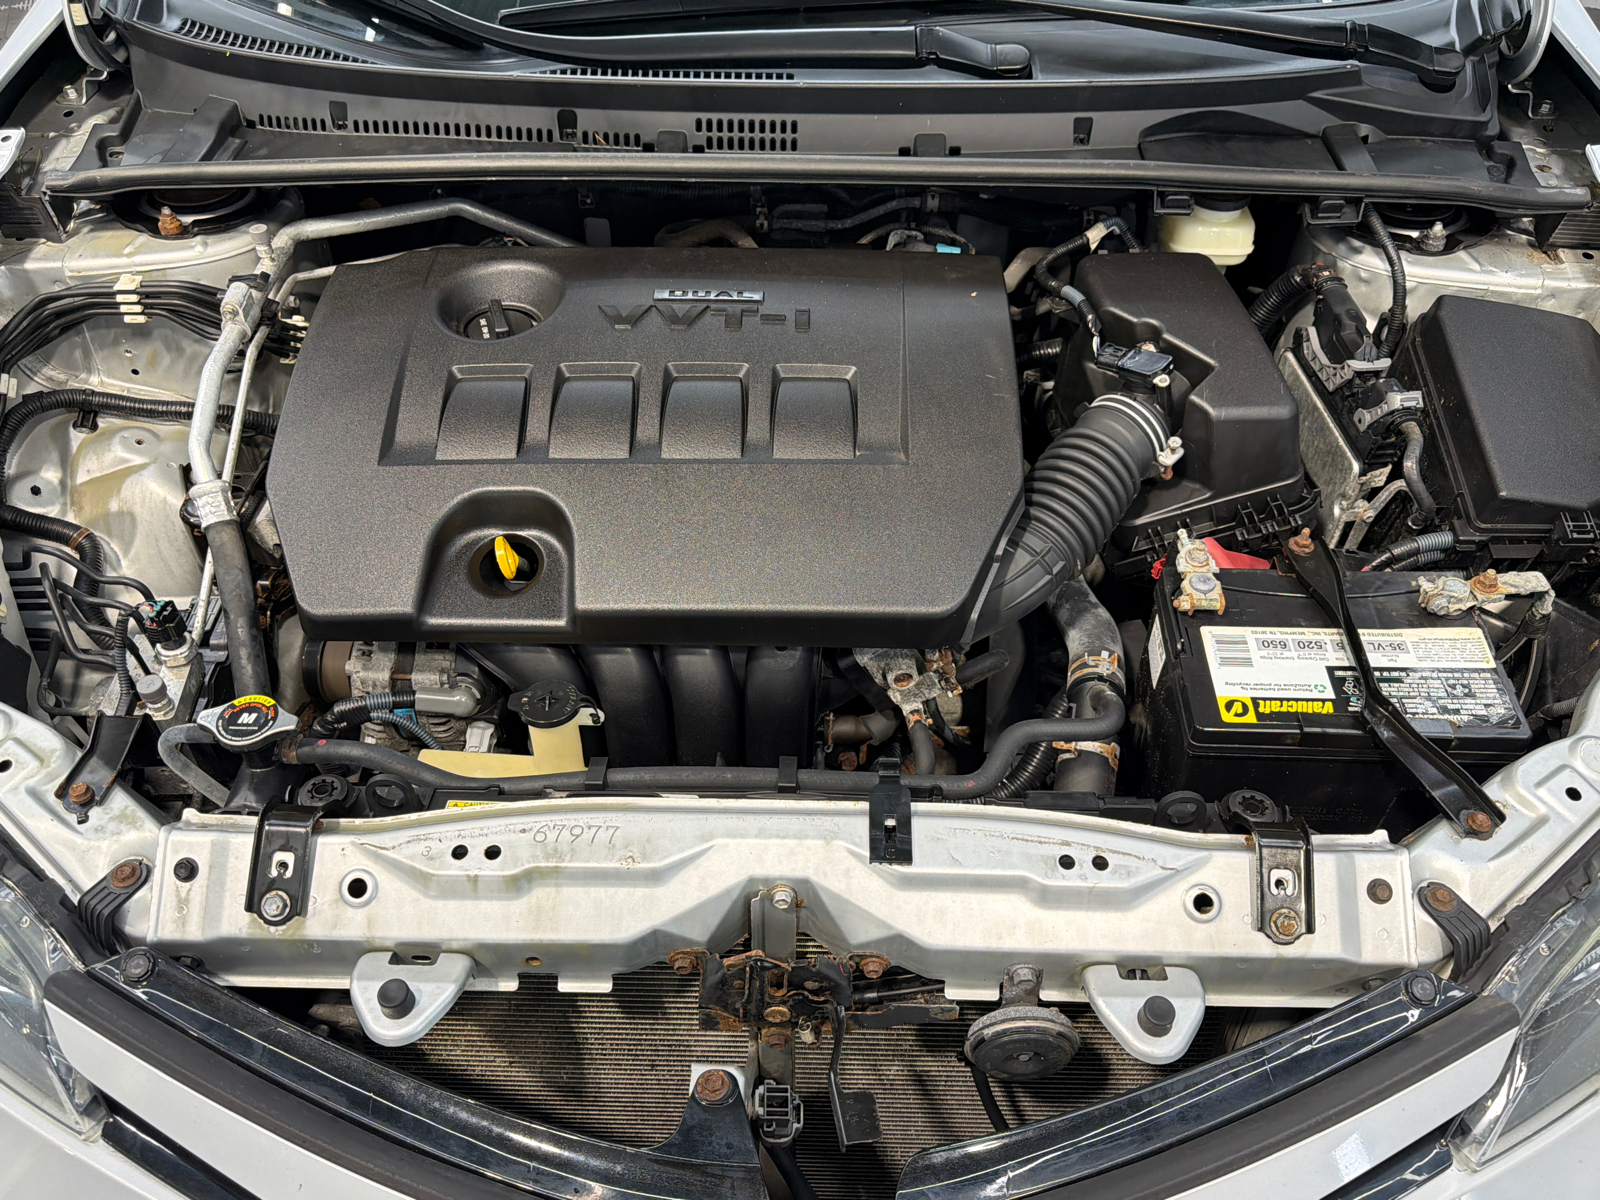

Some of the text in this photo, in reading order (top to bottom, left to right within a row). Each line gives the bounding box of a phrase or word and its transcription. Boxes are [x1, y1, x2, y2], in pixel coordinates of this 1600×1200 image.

[668, 290, 754, 299] DUAL
[1261, 639, 1288, 650] 650
[1297, 640, 1323, 650] 520
[1366, 642, 1405, 651] 35-VL
[1258, 700, 1334, 714] Valucraft
[237, 713, 258, 724] M
[532, 823, 621, 845] 67977
